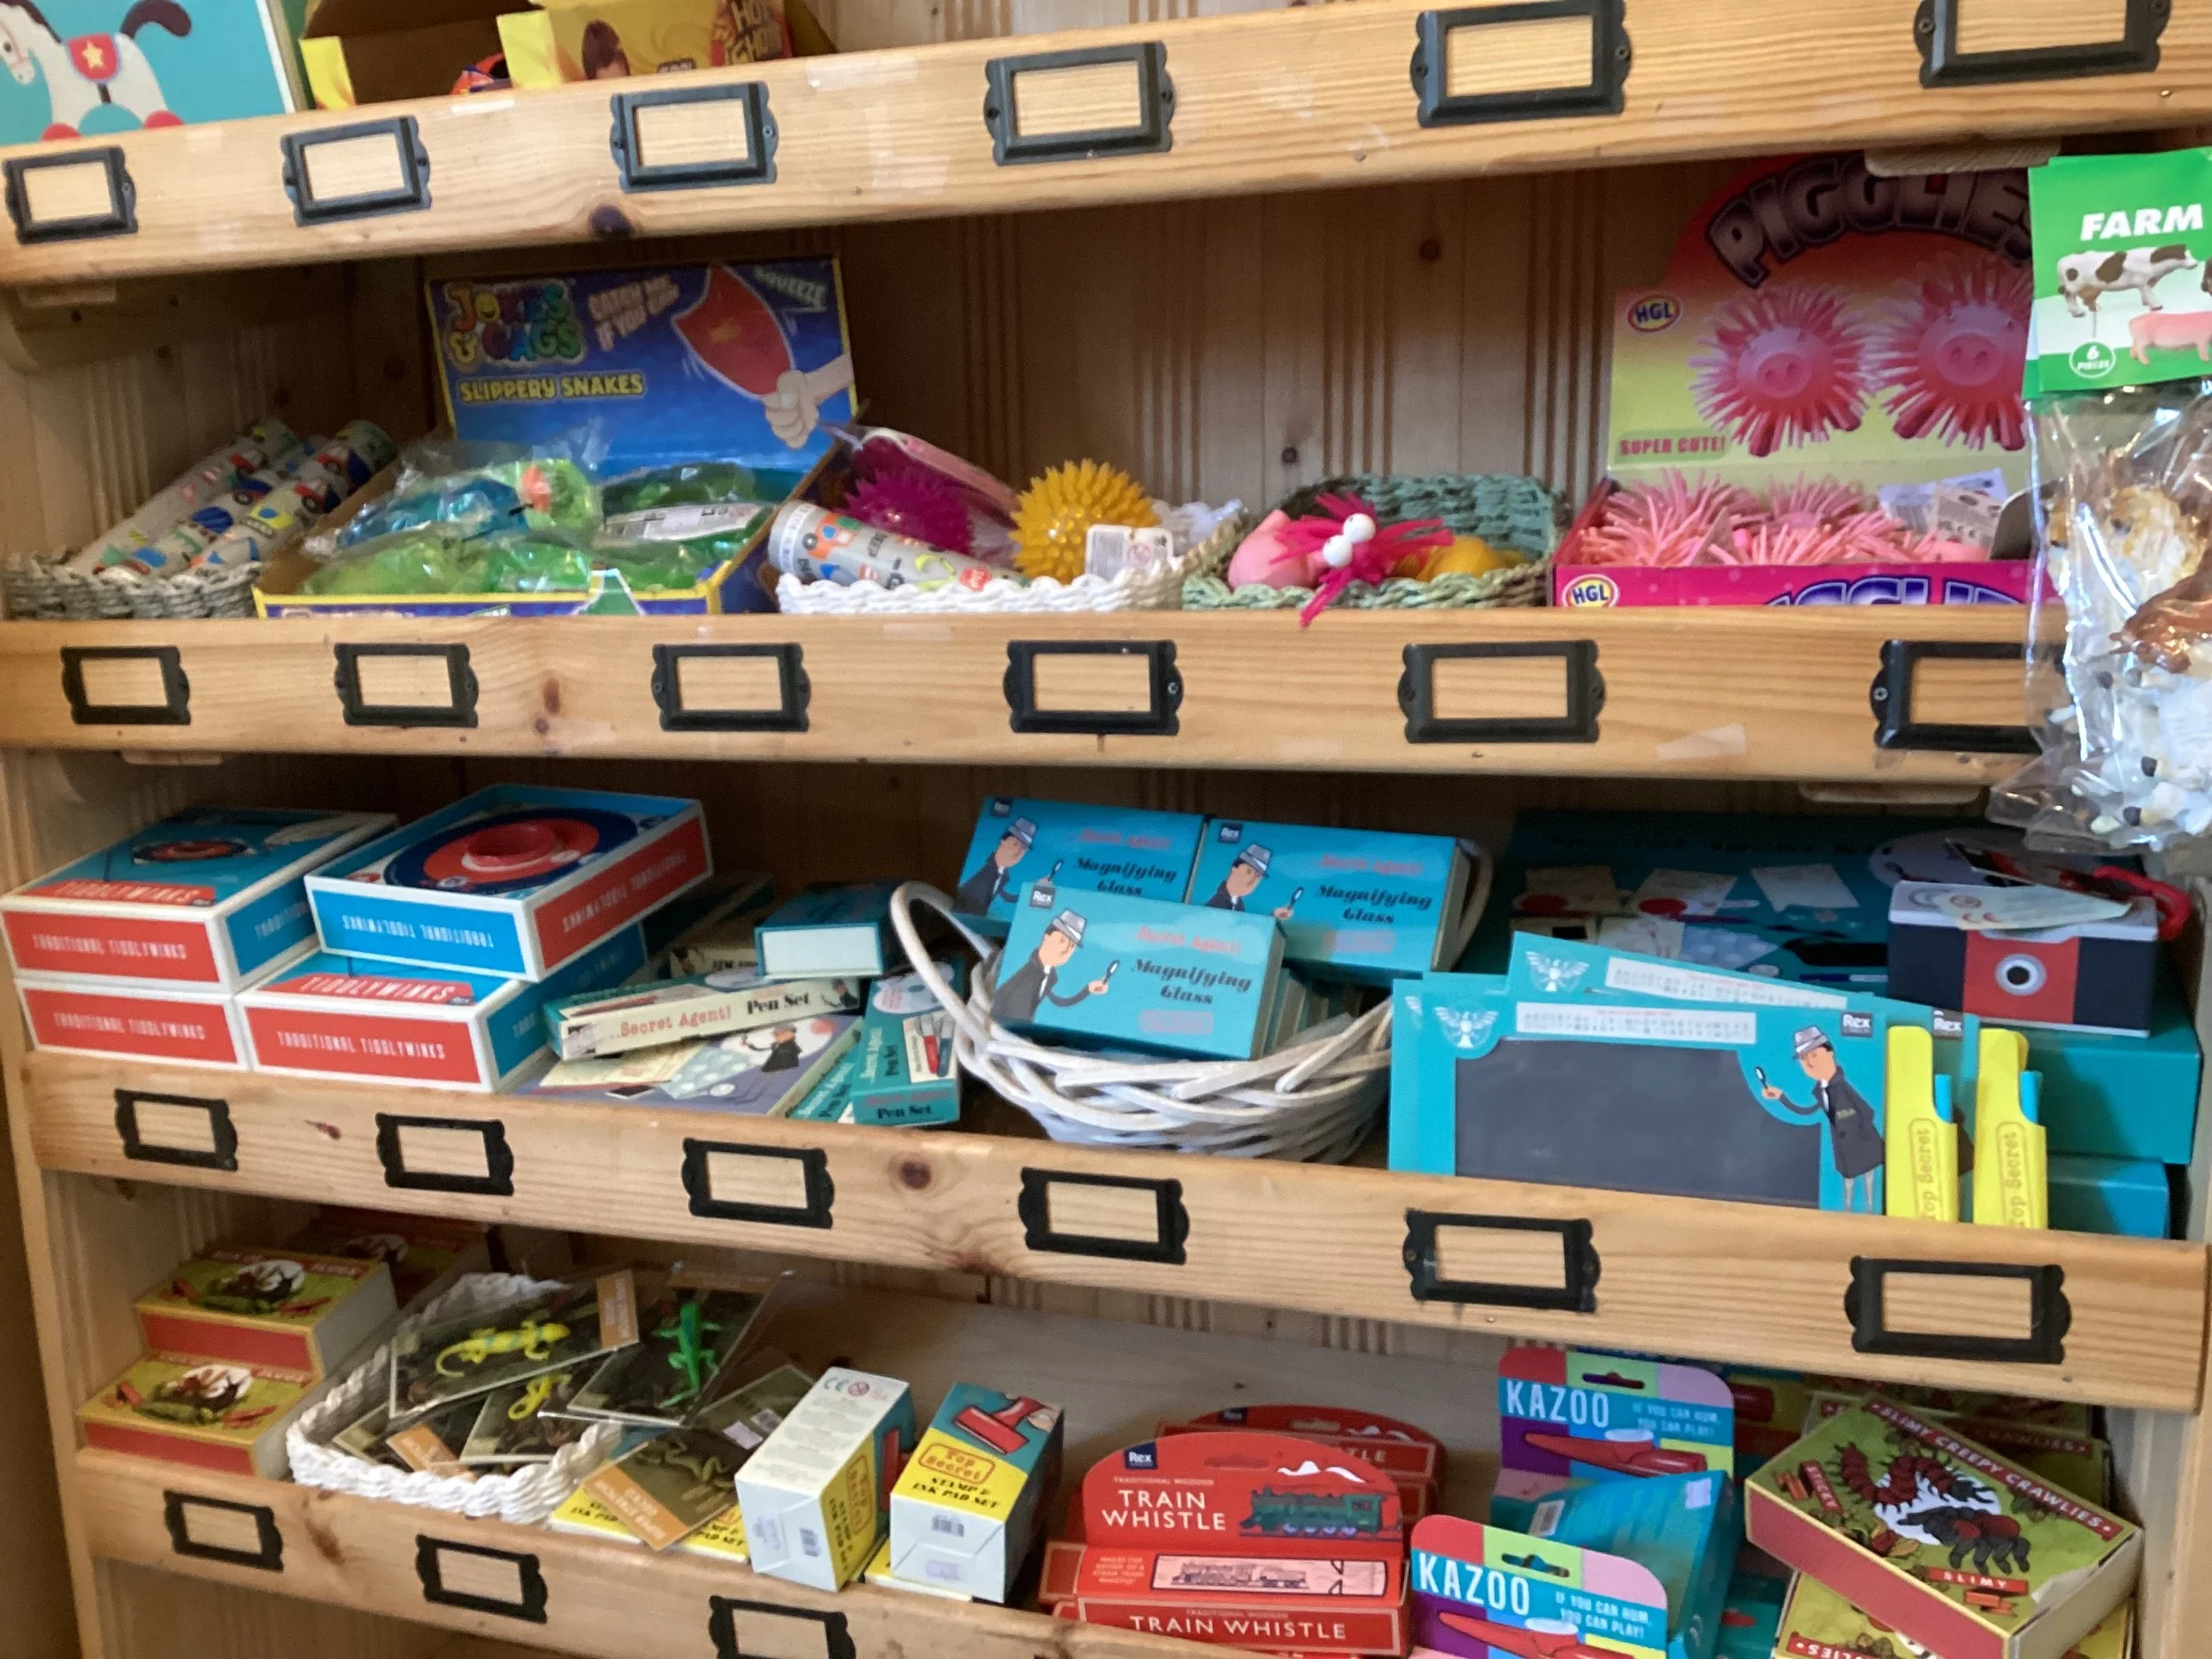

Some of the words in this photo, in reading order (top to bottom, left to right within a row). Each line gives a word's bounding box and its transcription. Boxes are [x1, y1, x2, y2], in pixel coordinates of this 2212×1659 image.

[2080, 204, 2203, 241] FARM
[1635, 302, 1673, 323] HGL
[2086, 344, 2100, 361] 6
[459, 376, 556, 403] SLIPPERY
[560, 373, 644, 398] SNAKES
[1619, 439, 1672, 455] SUPER
[1678, 434, 1725, 453] CUTE!
[1571, 583, 1609, 603] HGL
[1077, 856, 1178, 882] Magnifying
[1033, 890, 1053, 903] Rex
[1096, 880, 1143, 896] Glass
[1317, 885, 1433, 910] Magnifying
[1343, 907, 1395, 925] Glass
[1134, 958, 1253, 992] Magnifying
[747, 991, 780, 1015] Pen
[784, 987, 810, 1008] Set
[1161, 984, 1213, 1004] Glass
[620, 1015, 672, 1038] Secret
[680, 1003, 732, 1030] Agent!
[1842, 1013, 1871, 1029] Rex
[1933, 1017, 1962, 1033] Rex
[1916, 1127, 1935, 1184] Secret
[2003, 1130, 2024, 1188] Secret
[1506, 1379, 1609, 1428] KAZOO
[1128, 1451, 1153, 1463] Rex
[1879, 1405, 1934, 1436] SLIMY
[1934, 1435, 2004, 1475] CREEPY
[2004, 1472, 2103, 1528] CRAWLIES
[1118, 1489, 1206, 1509] TRAIN
[1102, 1509, 1226, 1531] WHISTLE
[1419, 1553, 1529, 1616] KAZOO
[1943, 1571, 2007, 1589] SLIMY
[1555, 1590, 1566, 1605] IF
[1570, 1594, 1593, 1611] YOU
[1595, 1599, 1619, 1618] CAN
[1129, 1616, 1215, 1635] TRAIN
[1224, 1619, 1347, 1640] WHISTLE
[1560, 1607, 1583, 1626] YOU
[1585, 1612, 1609, 1632] CAN
[1611, 1619, 1646, 1639] PLAY!
